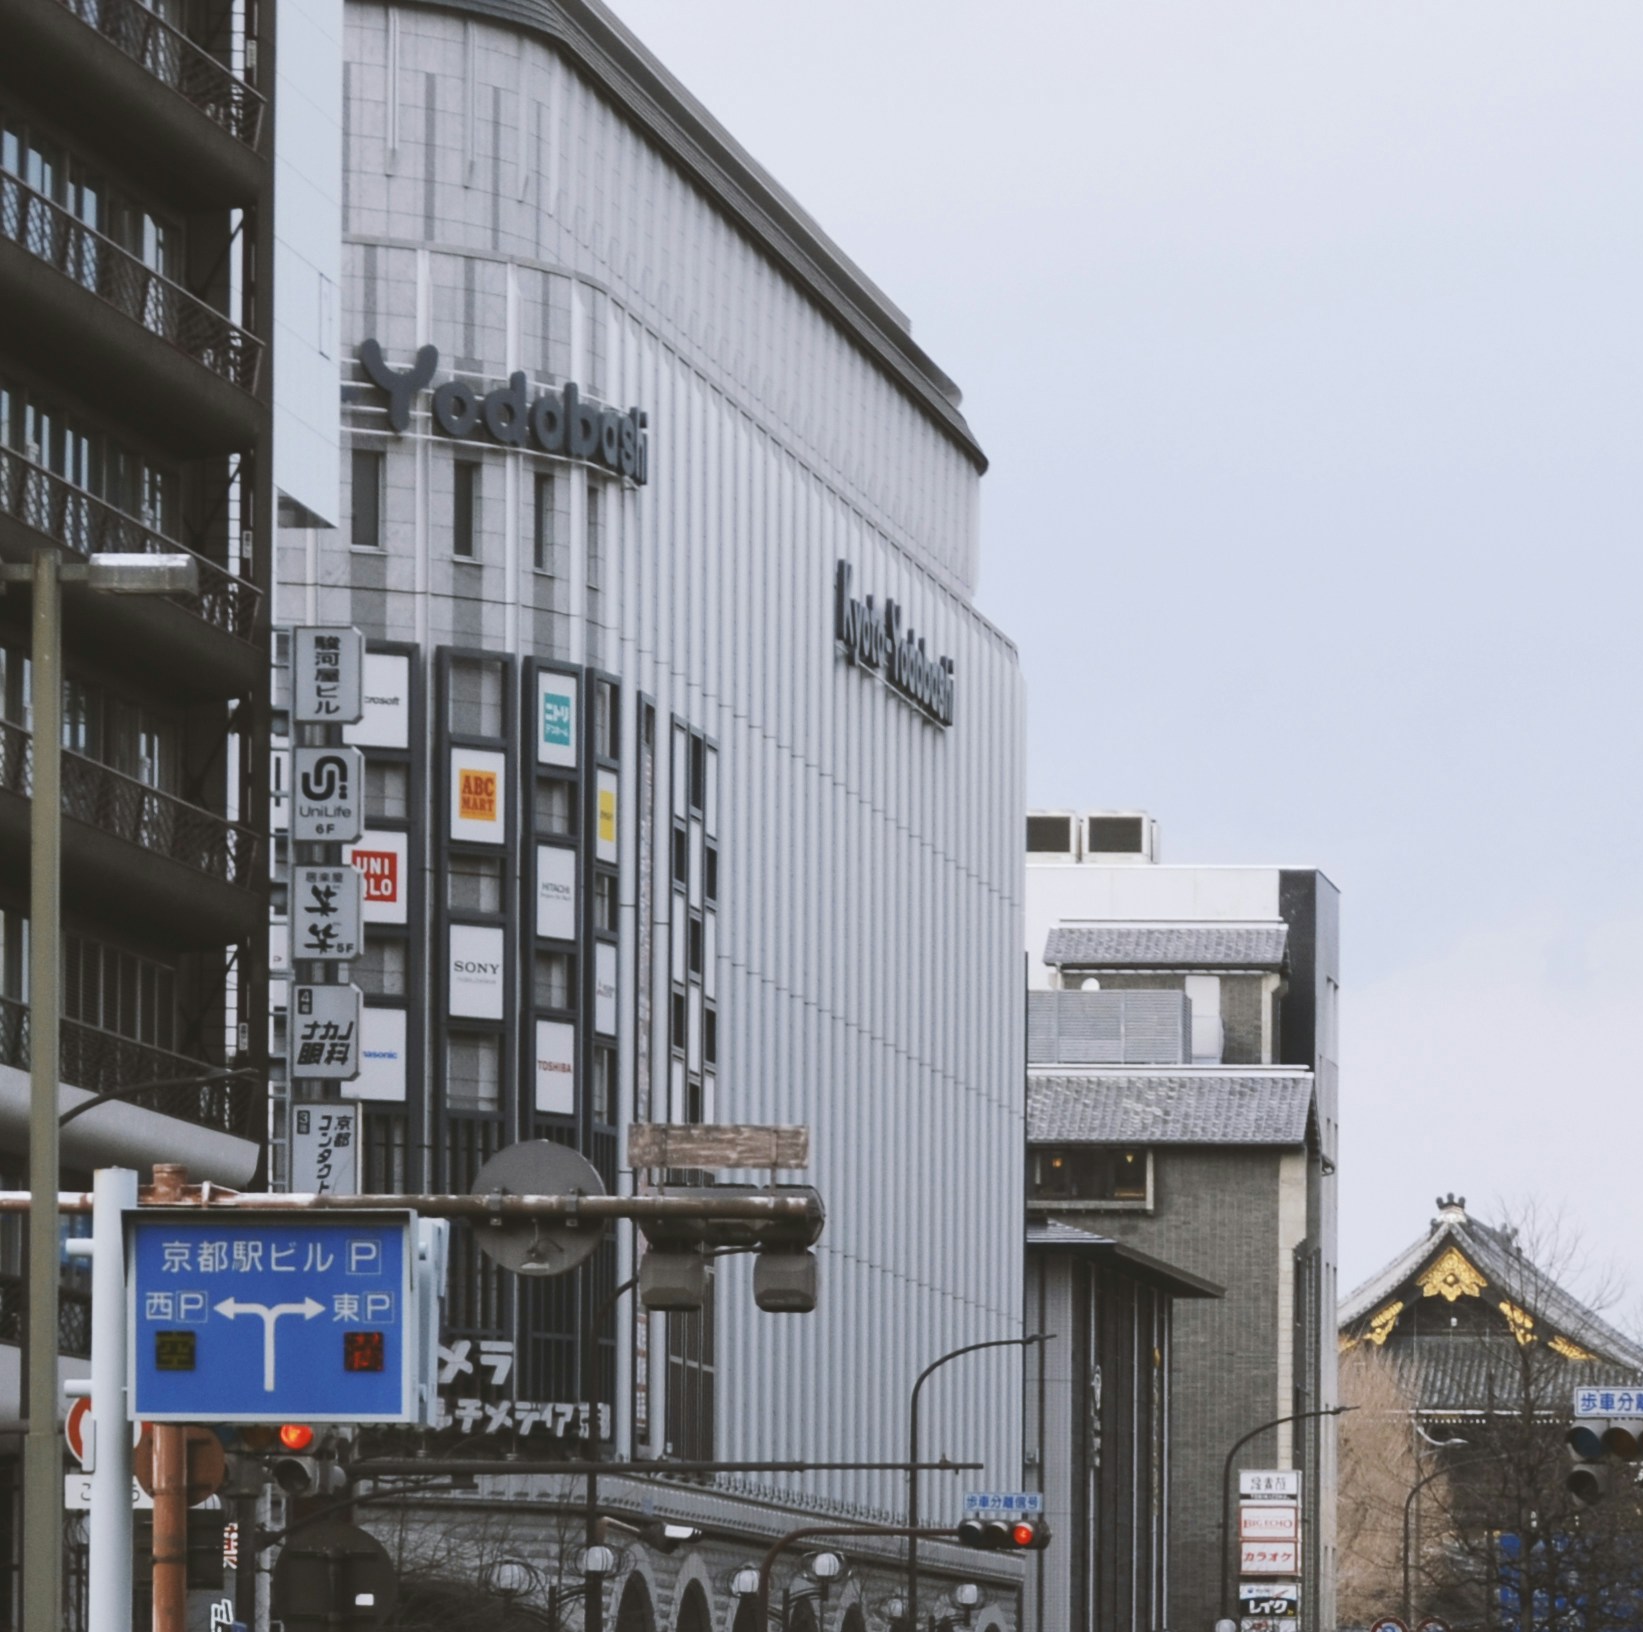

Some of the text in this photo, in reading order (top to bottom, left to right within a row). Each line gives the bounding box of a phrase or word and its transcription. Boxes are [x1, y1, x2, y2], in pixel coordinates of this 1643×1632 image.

[361, 337, 649, 486] Yodobashi
[314, 635, 340, 715] 駿河屋ビル
[462, 775, 495, 797] ABC
[299, 806, 351, 818] UniLife
[461, 796, 494, 812] MART
[315, 823, 335, 834] 6F
[356, 856, 389, 875] UNI
[337, 943, 354, 953] 5F
[454, 961, 500, 974] SONY
[301, 1021, 354, 1041] ナカノ
[297, 1043, 350, 1065] 眼科
[538, 1061, 571, 1073] TOSHIBA
[334, 1116, 353, 1148] 京都
[317, 1115, 332, 1194] コンタクト
[162, 1241, 377, 1273] 京都駅ビル P
[146, 1292, 203, 1320] 西 P
[333, 1294, 390, 1322] 東 P
[1244, 1552, 1292, 1562] カラオケ
[1250, 1600, 1288, 1614] レイク
